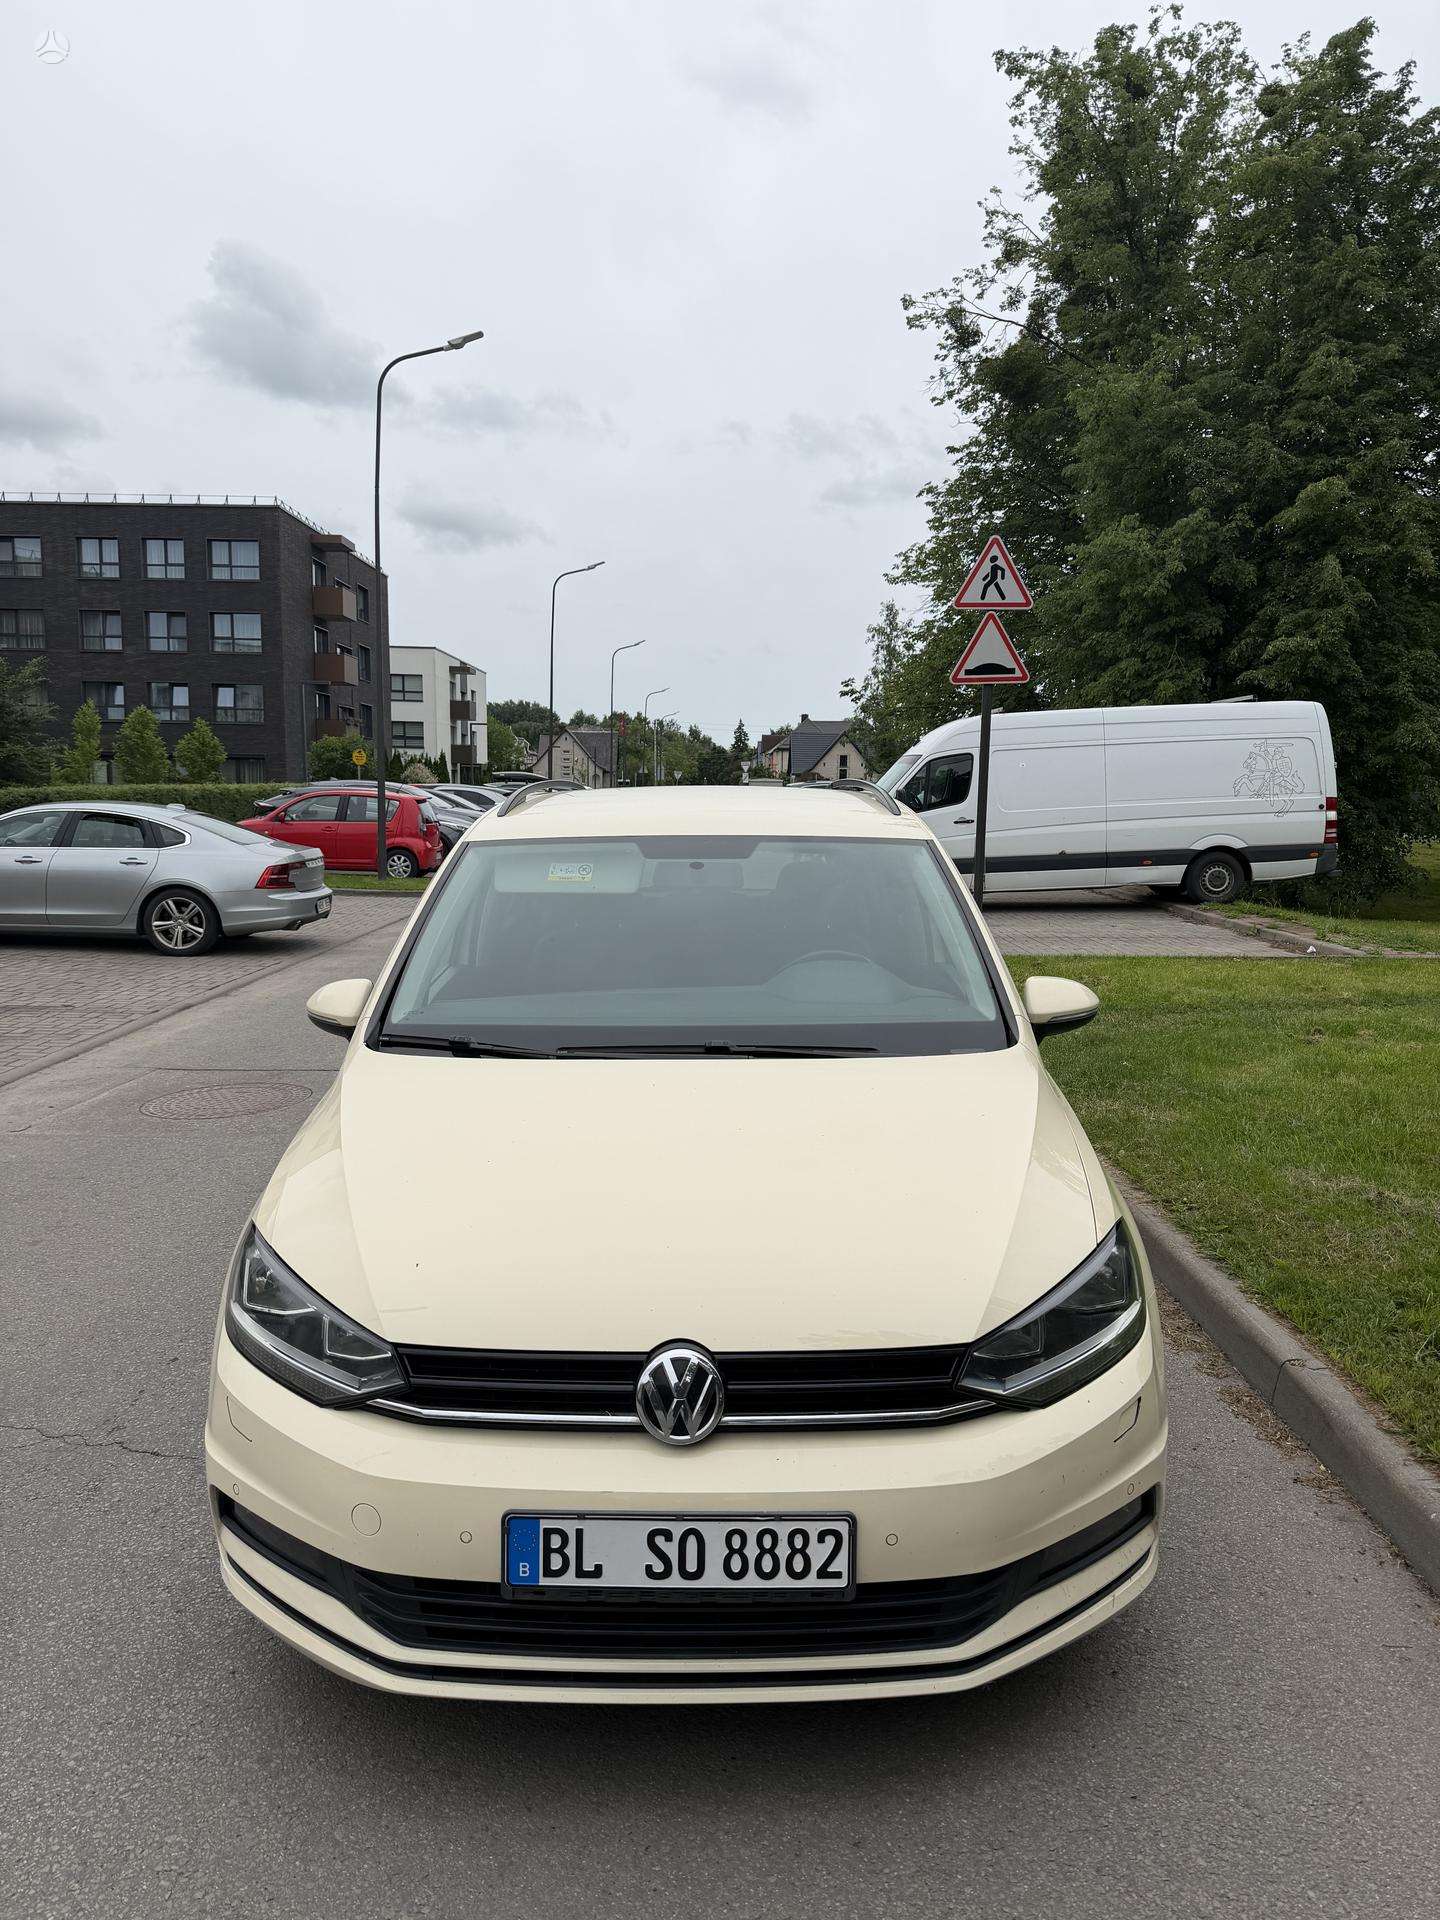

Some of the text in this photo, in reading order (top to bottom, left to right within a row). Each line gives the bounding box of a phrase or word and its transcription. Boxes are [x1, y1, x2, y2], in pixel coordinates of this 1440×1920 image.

[519, 1563, 530, 1577] B
[543, 1527, 843, 1580] BL SO 8882
